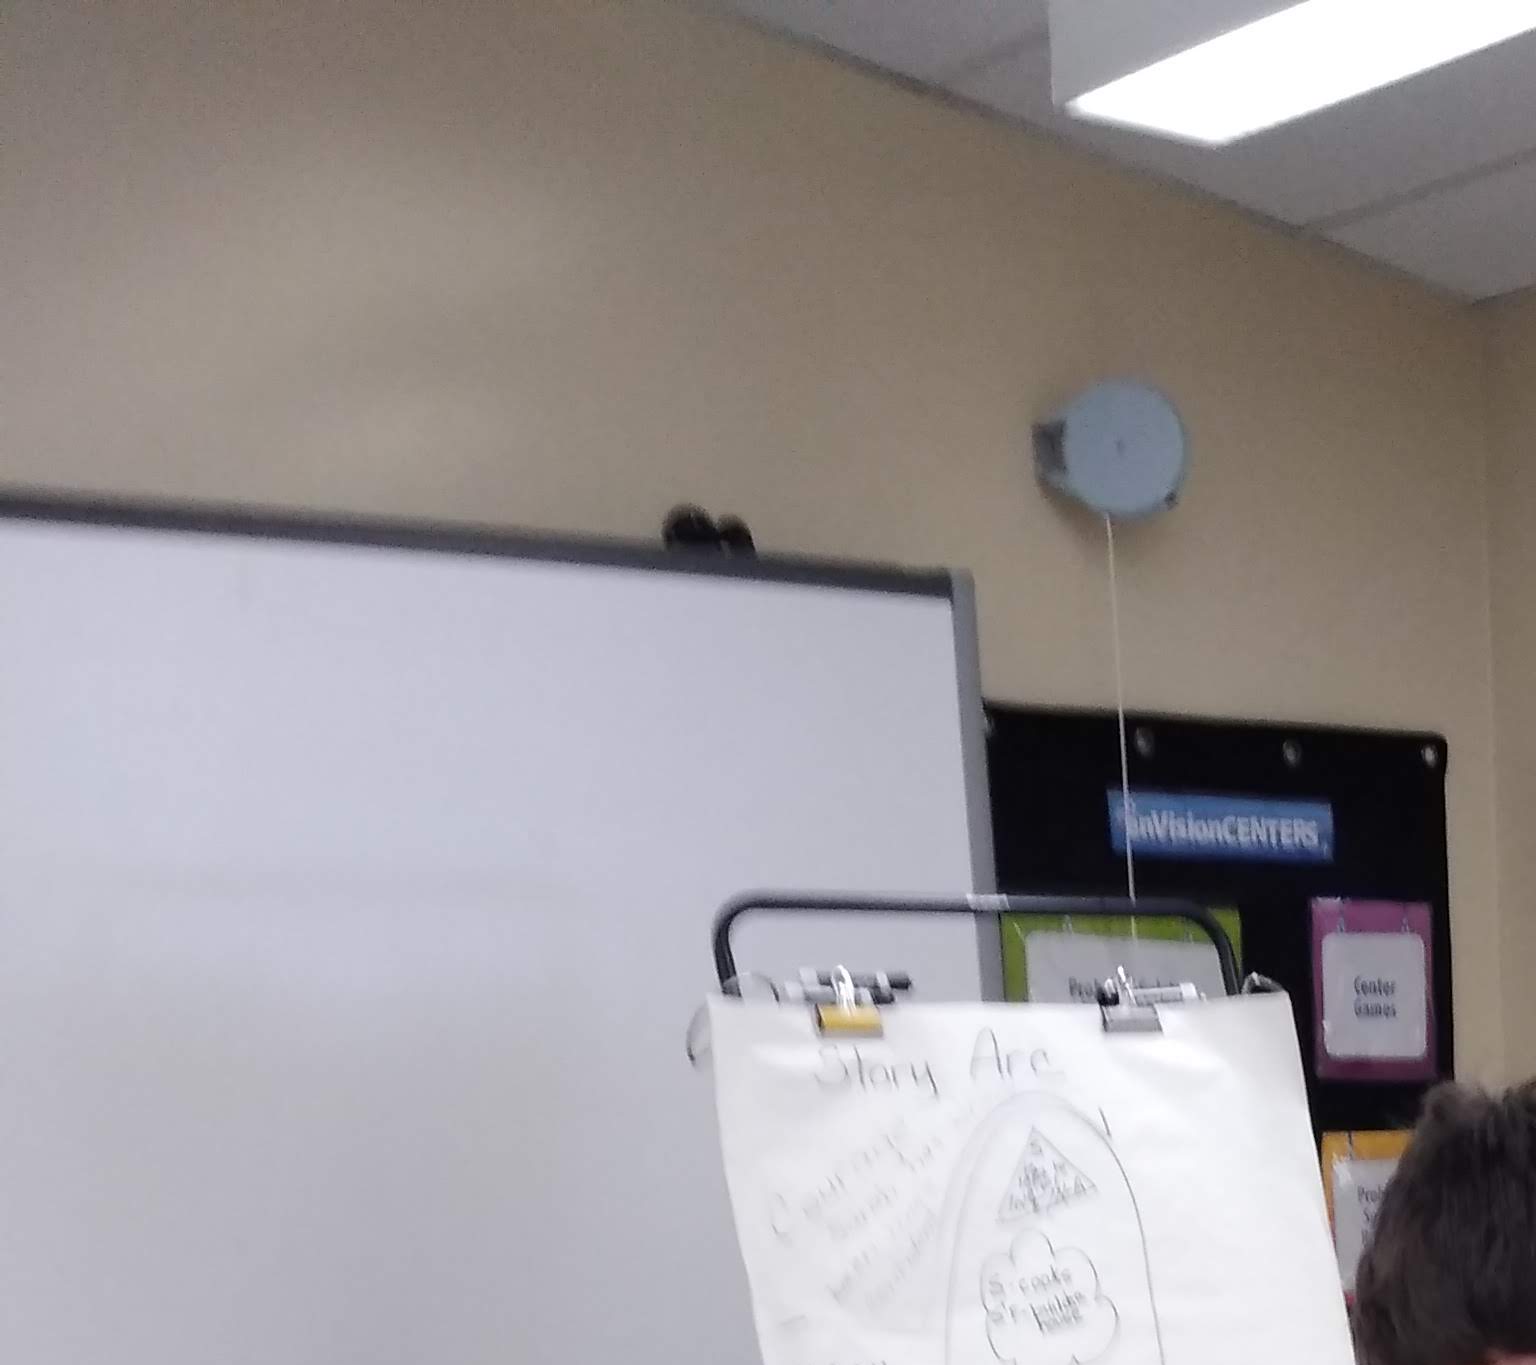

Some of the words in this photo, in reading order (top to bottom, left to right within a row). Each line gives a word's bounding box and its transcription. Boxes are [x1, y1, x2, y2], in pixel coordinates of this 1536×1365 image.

[1353, 974, 1397, 997] Center
[1353, 998, 1398, 1018] Games
[814, 1042, 940, 1101] Story
[969, 1026, 1065, 1081] Arc
